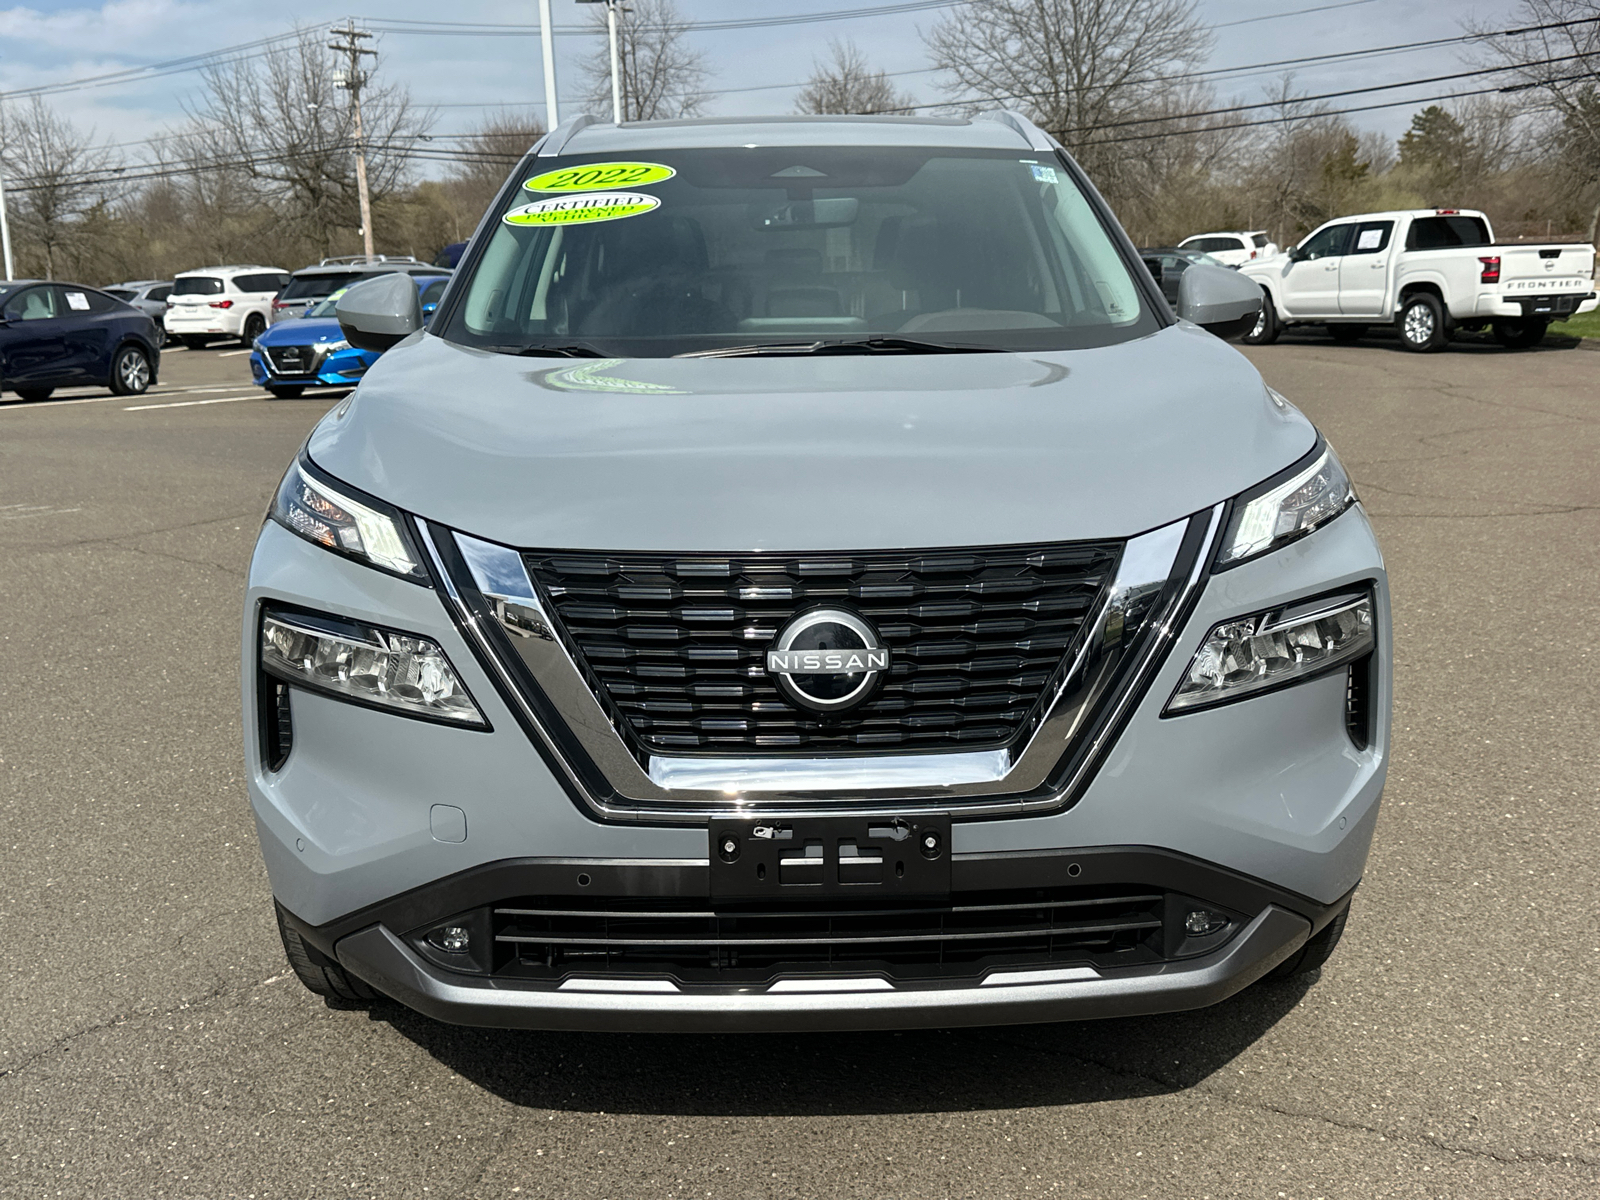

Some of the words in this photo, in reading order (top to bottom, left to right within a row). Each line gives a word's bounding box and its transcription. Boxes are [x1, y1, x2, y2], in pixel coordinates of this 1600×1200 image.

[545, 167, 652, 189] 2022
[523, 197, 645, 214] CERTIFIED
[1507, 280, 1582, 289] FRONTIER
[771, 652, 885, 669] NISSAN
